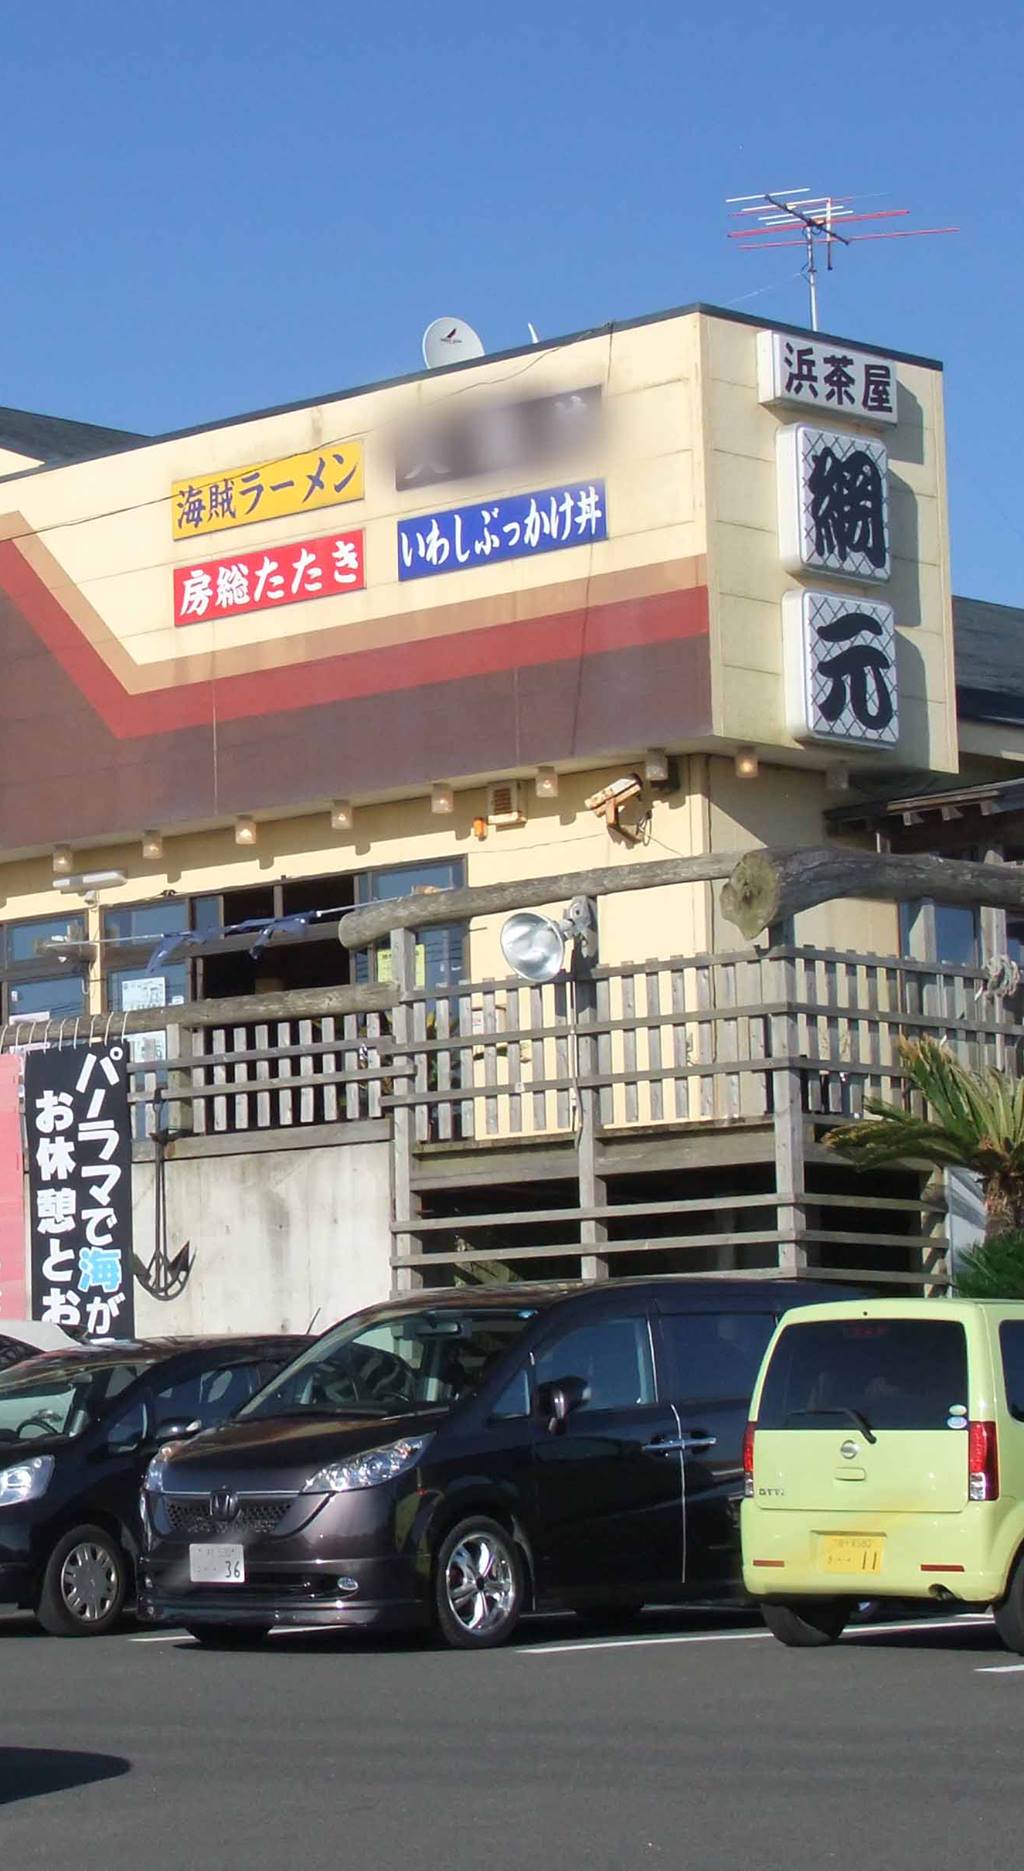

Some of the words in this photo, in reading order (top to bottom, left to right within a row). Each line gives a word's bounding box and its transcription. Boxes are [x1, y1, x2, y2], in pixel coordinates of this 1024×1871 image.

[784, 342, 893, 413] 浜茶屋
[177, 452, 359, 528] 海賊ラーメン
[401, 486, 602, 568] いわしぶっかけ丼
[179, 541, 359, 616] 房総たたき
[76, 1046, 126, 1343] パノラマで海が
